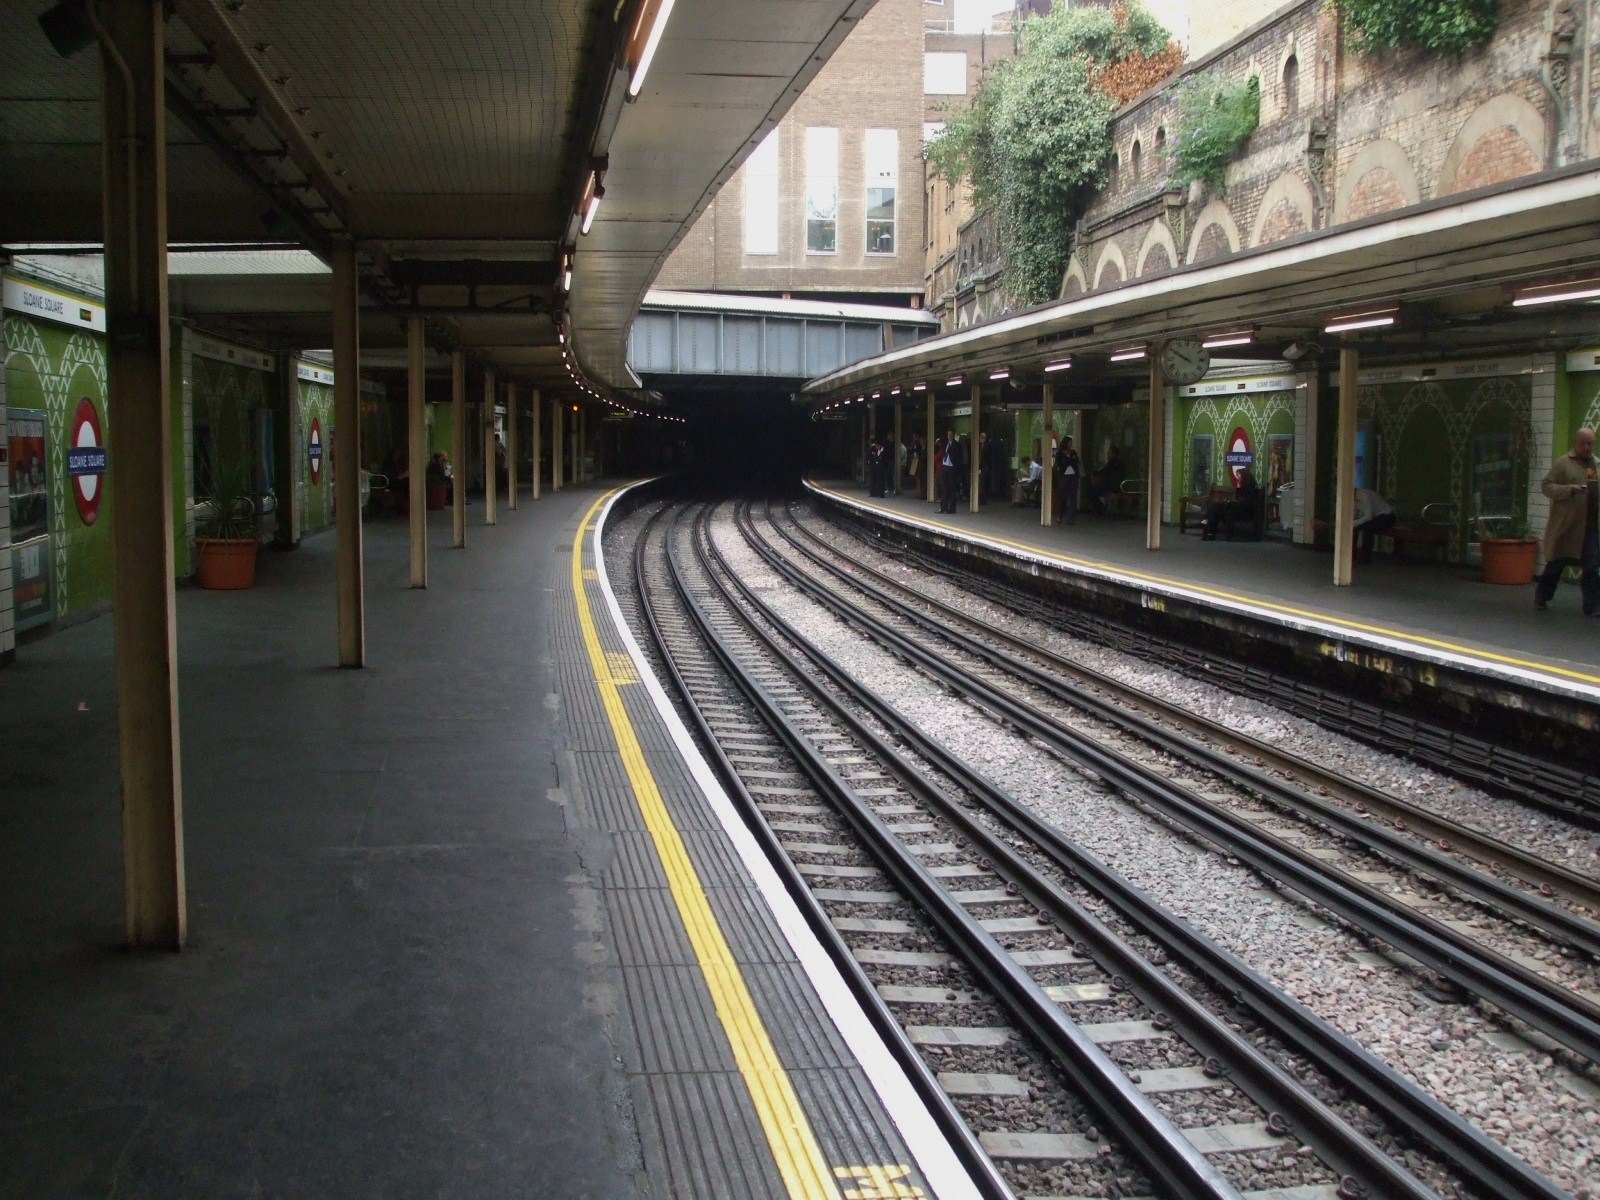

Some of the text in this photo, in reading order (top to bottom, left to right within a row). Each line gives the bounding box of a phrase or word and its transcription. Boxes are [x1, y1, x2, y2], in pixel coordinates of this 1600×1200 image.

[23, 291, 64, 315] SLOANE SQUARE
[69, 454, 105, 469] SLOANE SQUARE
